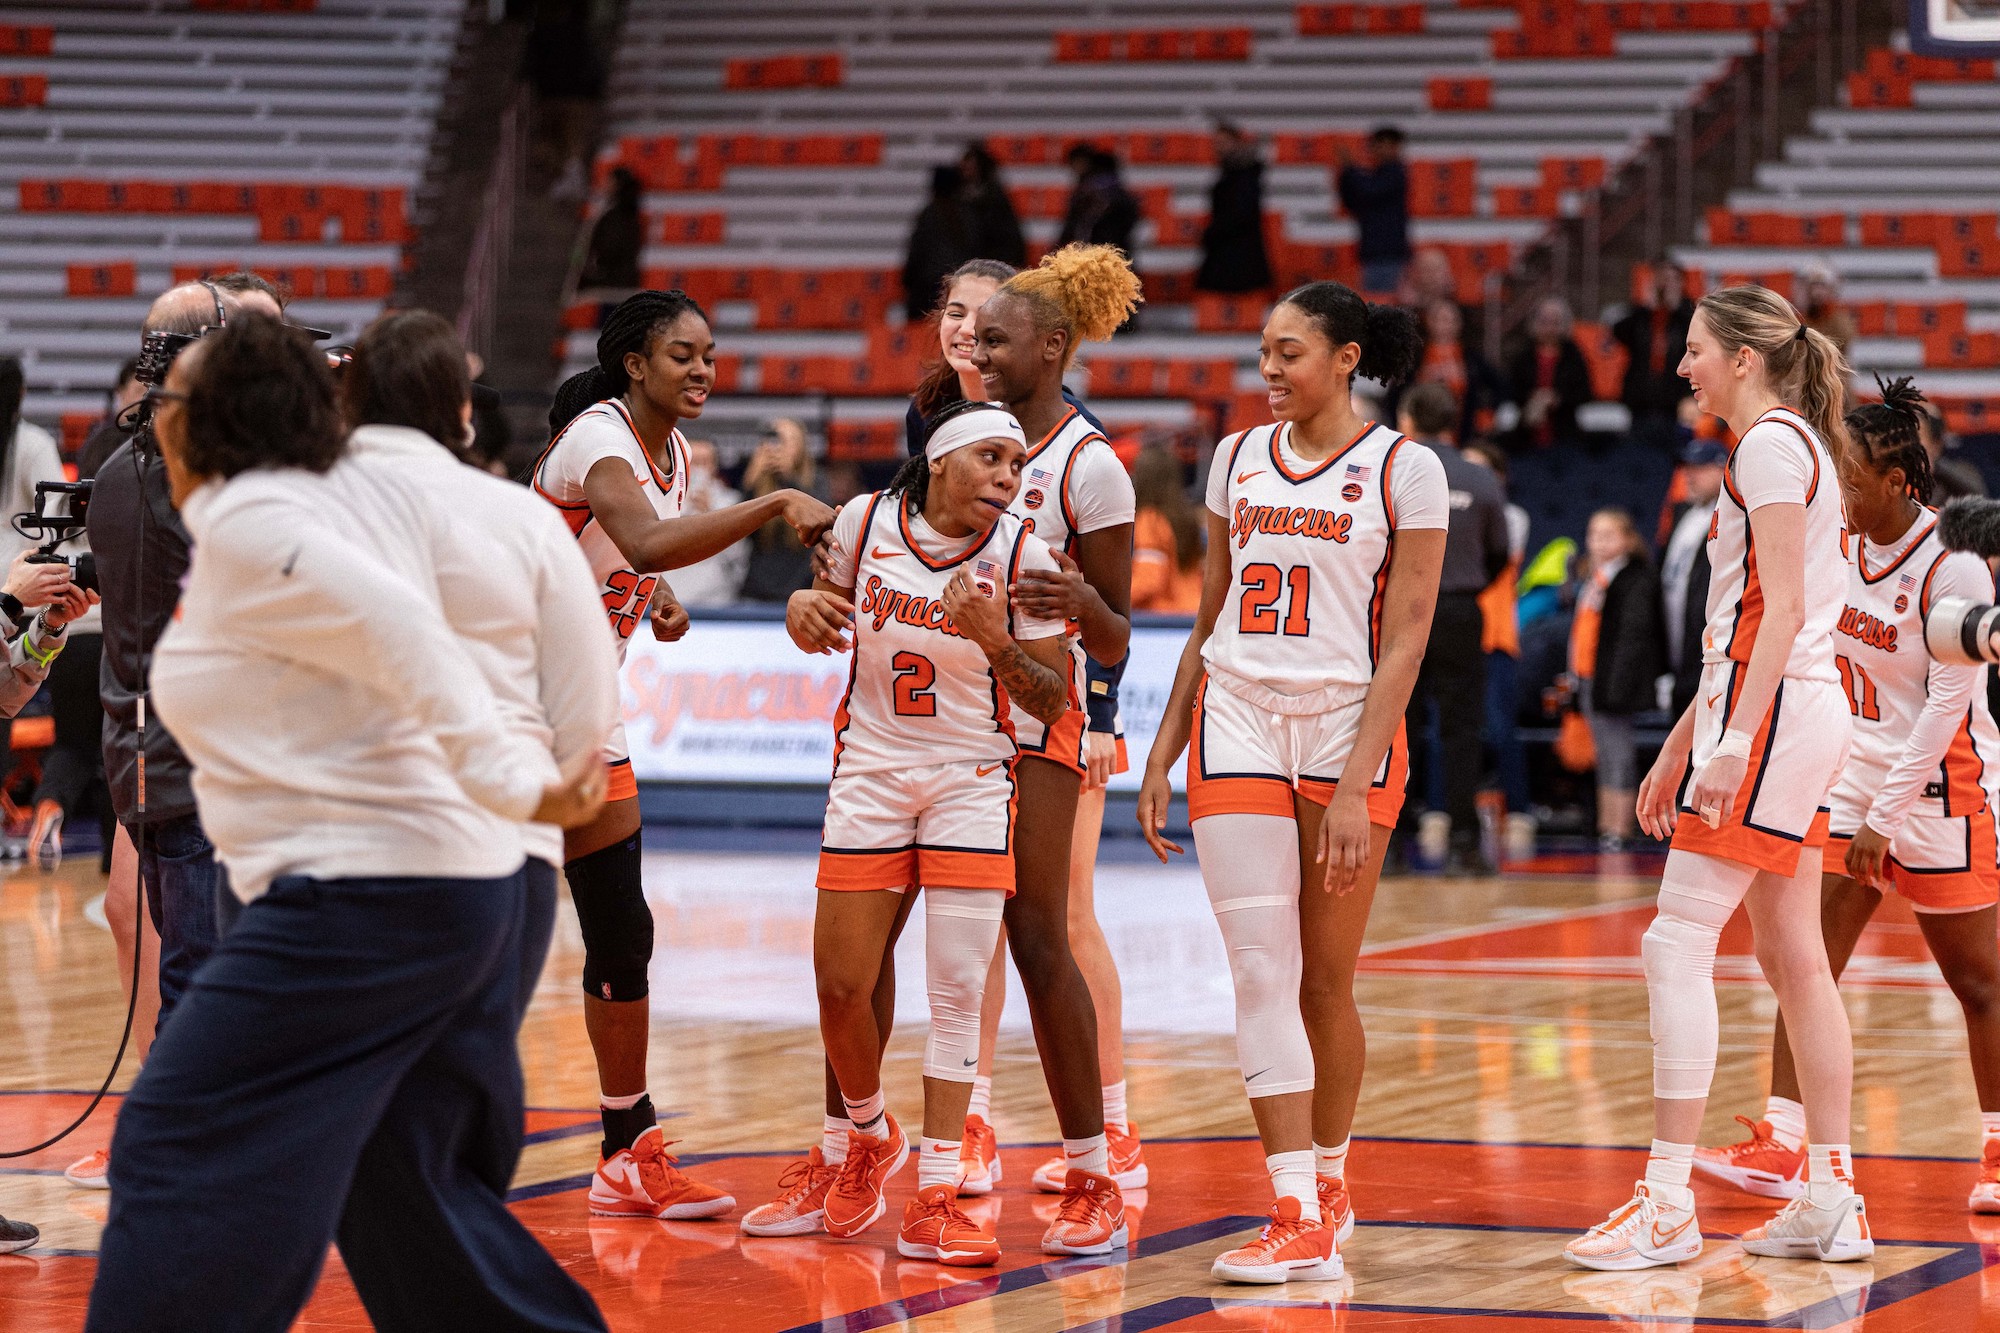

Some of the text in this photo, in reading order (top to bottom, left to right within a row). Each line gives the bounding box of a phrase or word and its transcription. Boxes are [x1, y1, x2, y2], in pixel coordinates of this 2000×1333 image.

[1231, 498, 1353, 549] Syracuse
[601, 569, 657, 639] 23
[1239, 562, 1310, 638] 21
[622, 655, 841, 746] Syracuse
[892, 650, 937, 717] 2
[1835, 653, 1881, 723] 11
